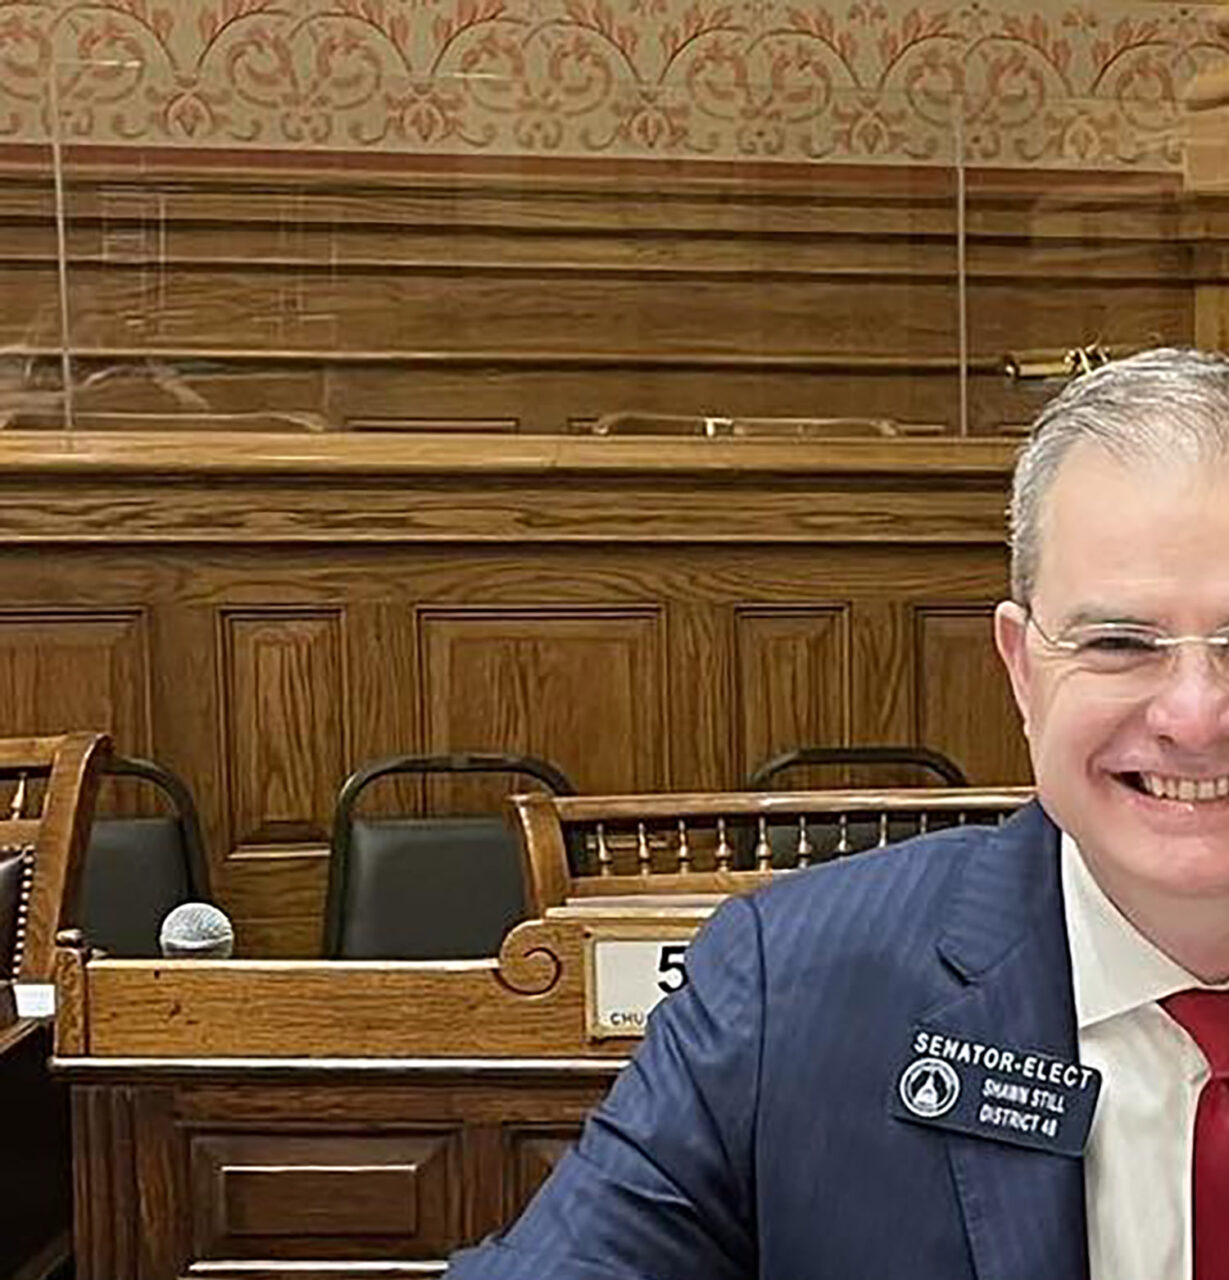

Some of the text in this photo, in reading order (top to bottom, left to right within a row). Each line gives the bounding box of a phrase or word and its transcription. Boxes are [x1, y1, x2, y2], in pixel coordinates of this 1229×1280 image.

[657, 946, 689, 993] 5
[610, 1012, 644, 1026] CHU
[913, 1032, 1093, 1090] SENATOR-ELECT
[982, 1078, 1065, 1113] SHAWN STILL
[979, 1103, 1058, 1138] DISTRICT 48
